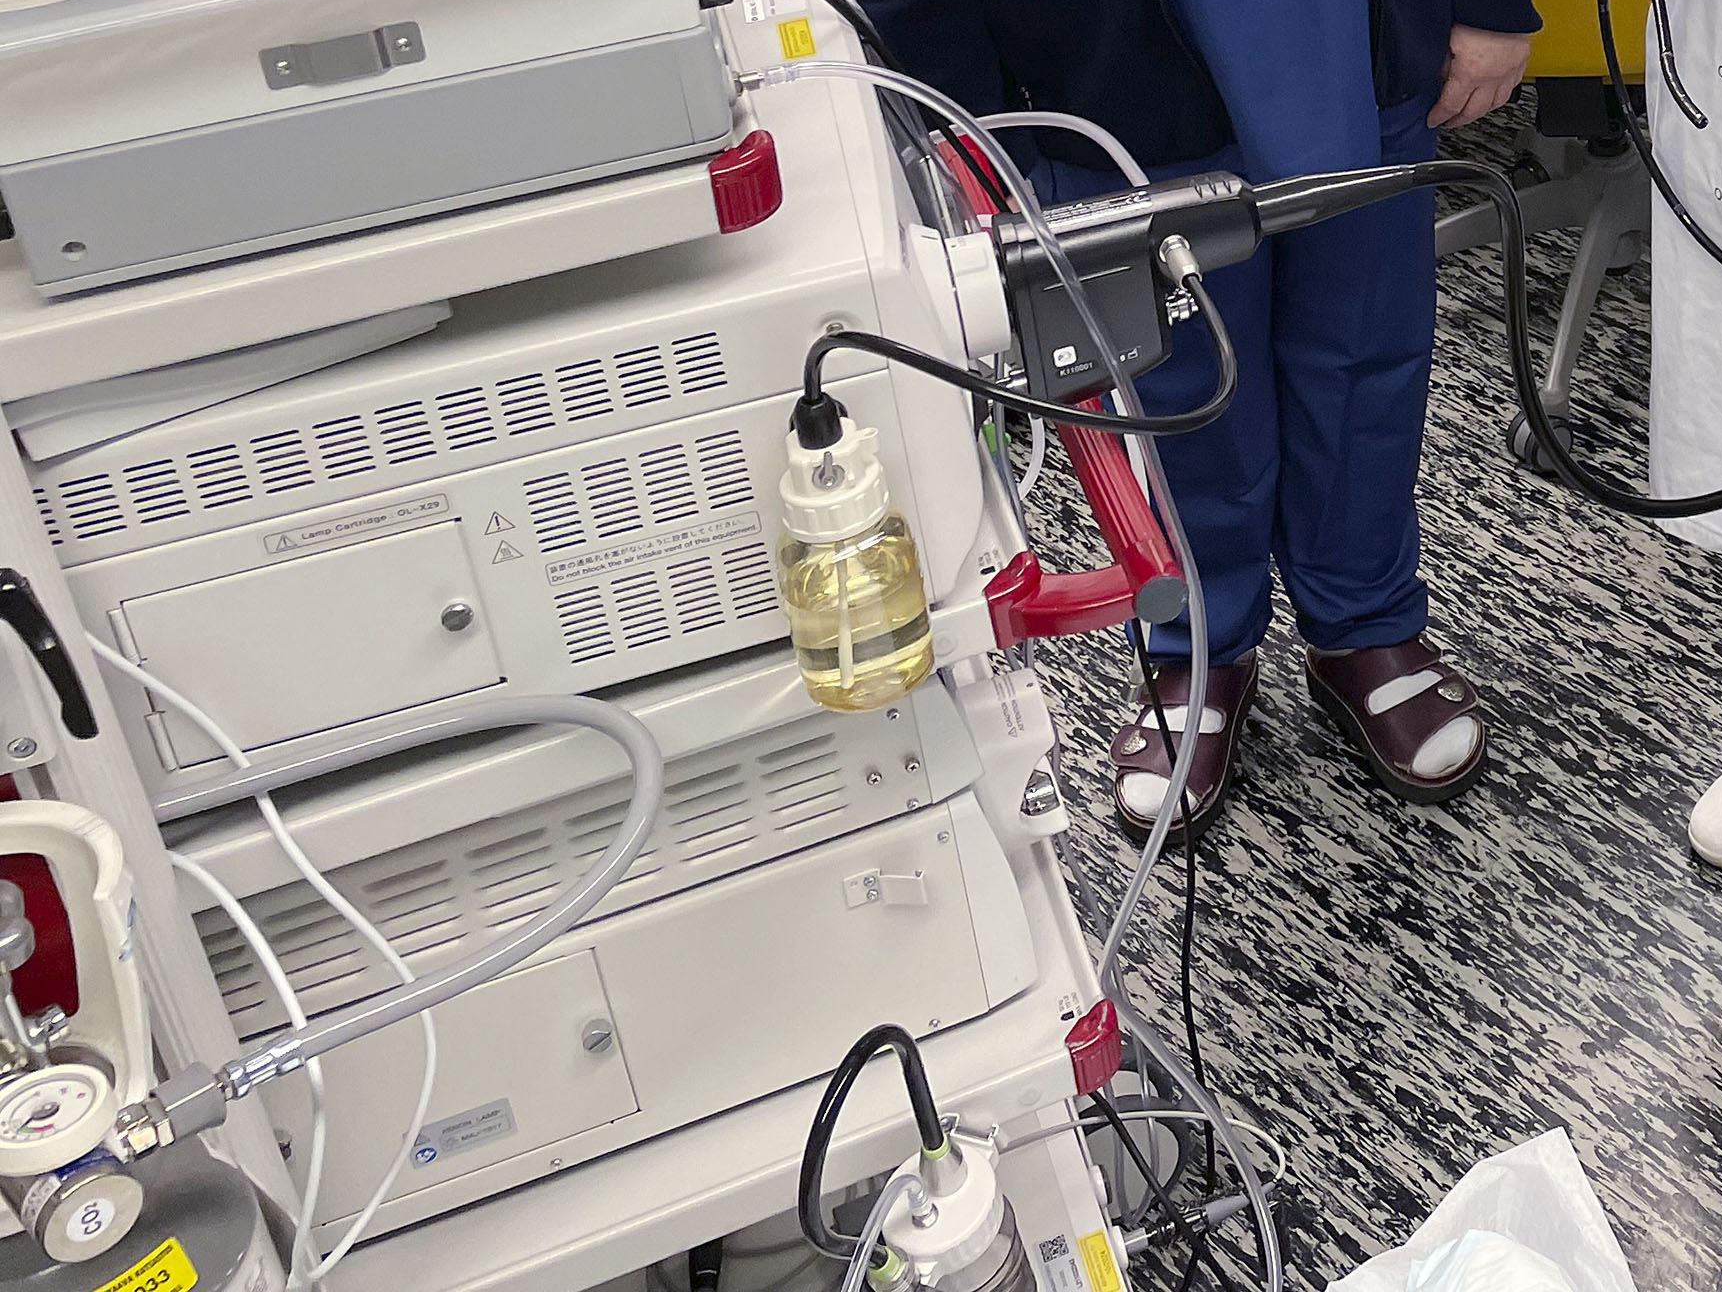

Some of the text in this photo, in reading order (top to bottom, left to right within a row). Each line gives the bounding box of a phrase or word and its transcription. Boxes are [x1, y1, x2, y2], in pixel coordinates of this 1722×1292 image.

[301, 527, 332, 540] Lamp
[335, 514, 387, 532] Cartridge
[551, 573, 564, 582] Do
[565, 569, 581, 578] not
[582, 562, 606, 574] block
[608, 558, 622, 567] the
[624, 555, 635, 563] air
[636, 548, 662, 560] intake
[664, 544, 682, 553] vent
[684, 540, 693, 548] of
[694, 535, 710, 545] this
